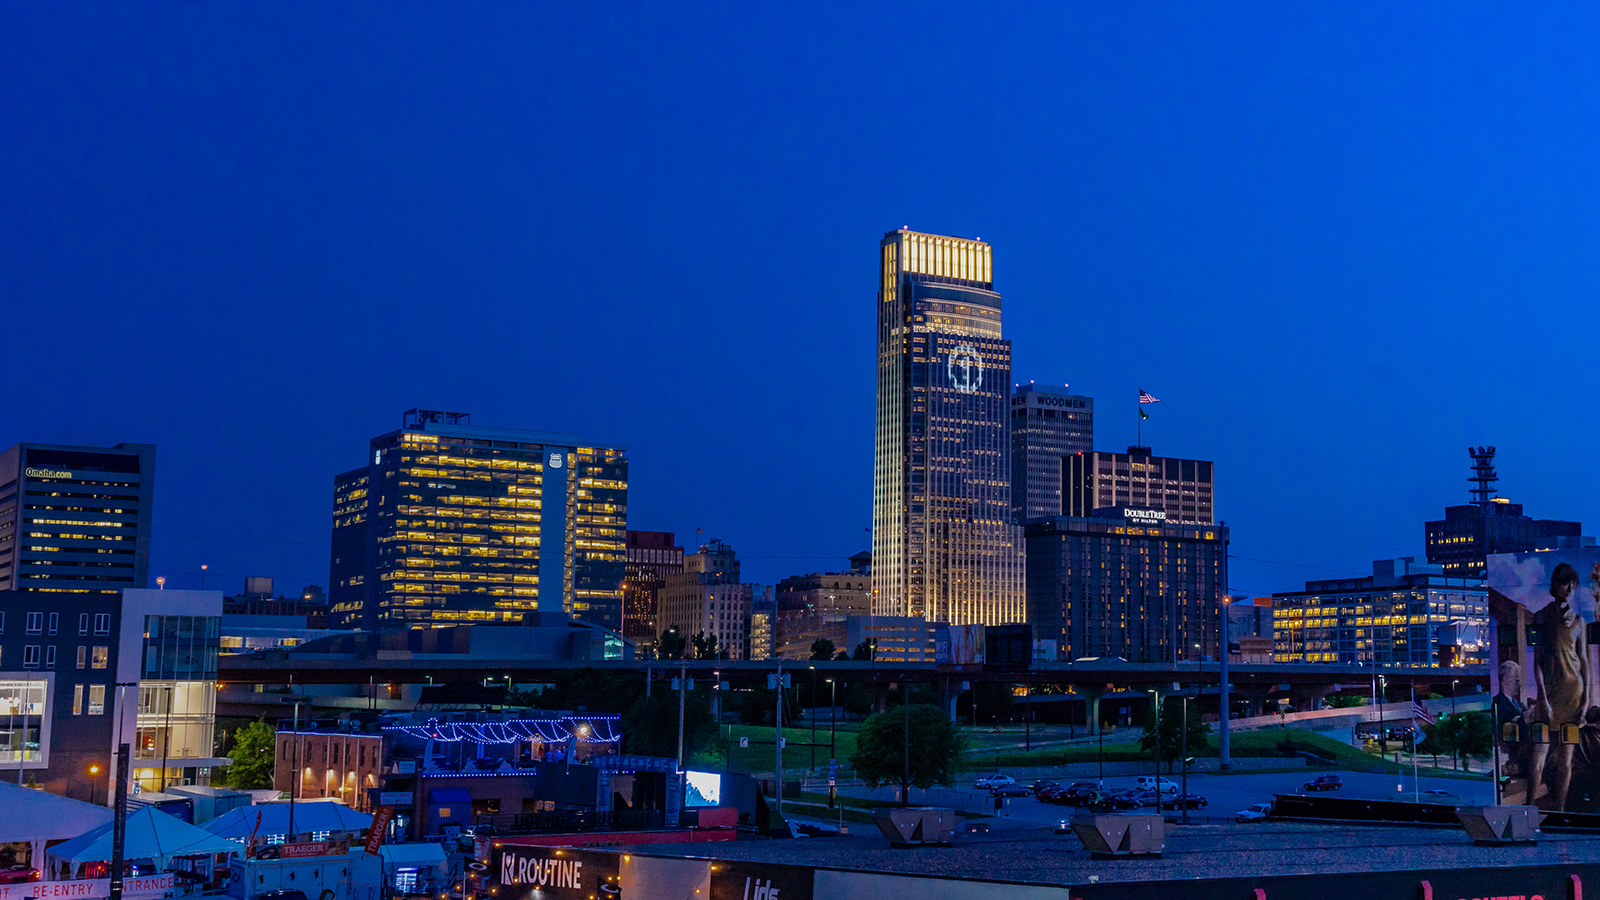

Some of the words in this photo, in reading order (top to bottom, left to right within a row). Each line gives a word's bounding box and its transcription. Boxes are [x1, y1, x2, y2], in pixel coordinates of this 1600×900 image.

[1037, 396, 1085, 409] WOODMEN
[25, 467, 72, 479] Omaha.com
[367, 813, 388, 852] TRAEGER
[284, 844, 323, 854] TRAEGER
[519, 857, 582, 889] ROUTINE
[33, 883, 94, 898] RE-ENTRY
[122, 877, 173, 892] NTRANCE
